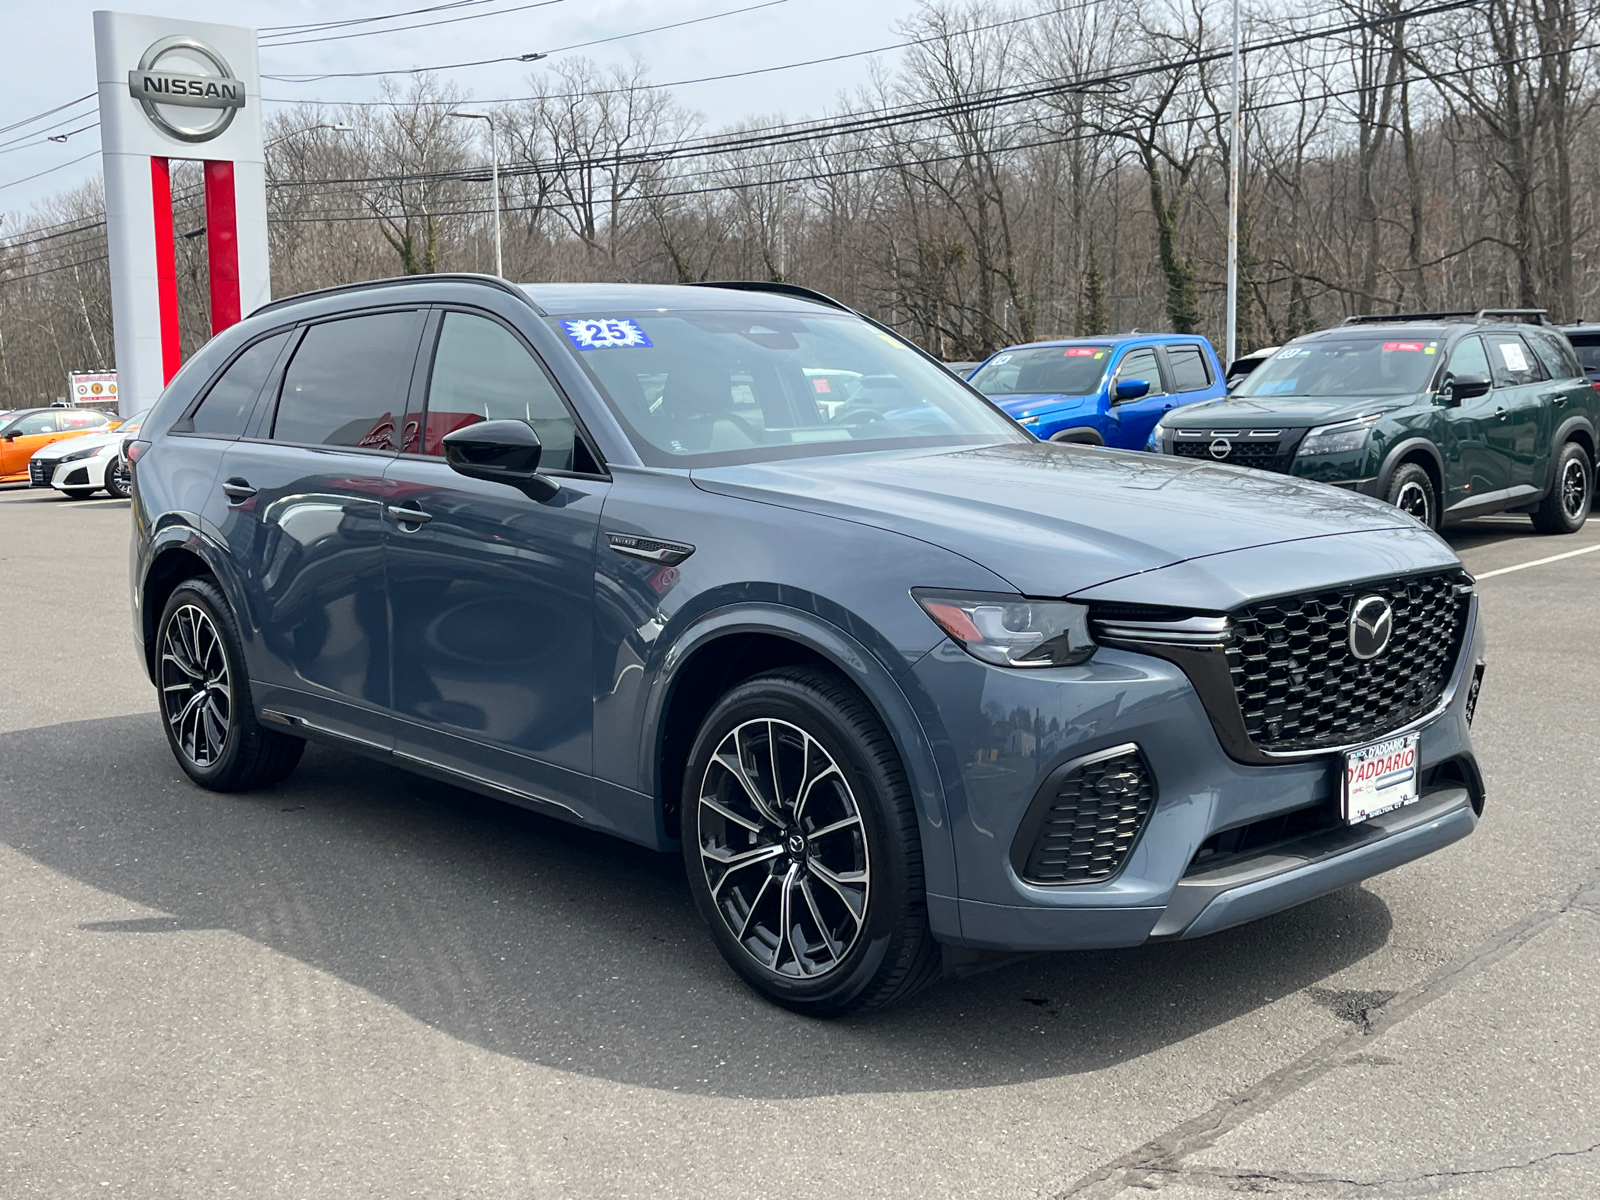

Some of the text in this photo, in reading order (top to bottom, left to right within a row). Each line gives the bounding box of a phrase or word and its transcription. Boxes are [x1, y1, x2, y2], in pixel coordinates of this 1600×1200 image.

[143, 76, 236, 100] NISSAN
[585, 323, 626, 342] 25
[1369, 738, 1404, 758] D'ADDARIO
[1348, 748, 1415, 784] D'ADDARIO
